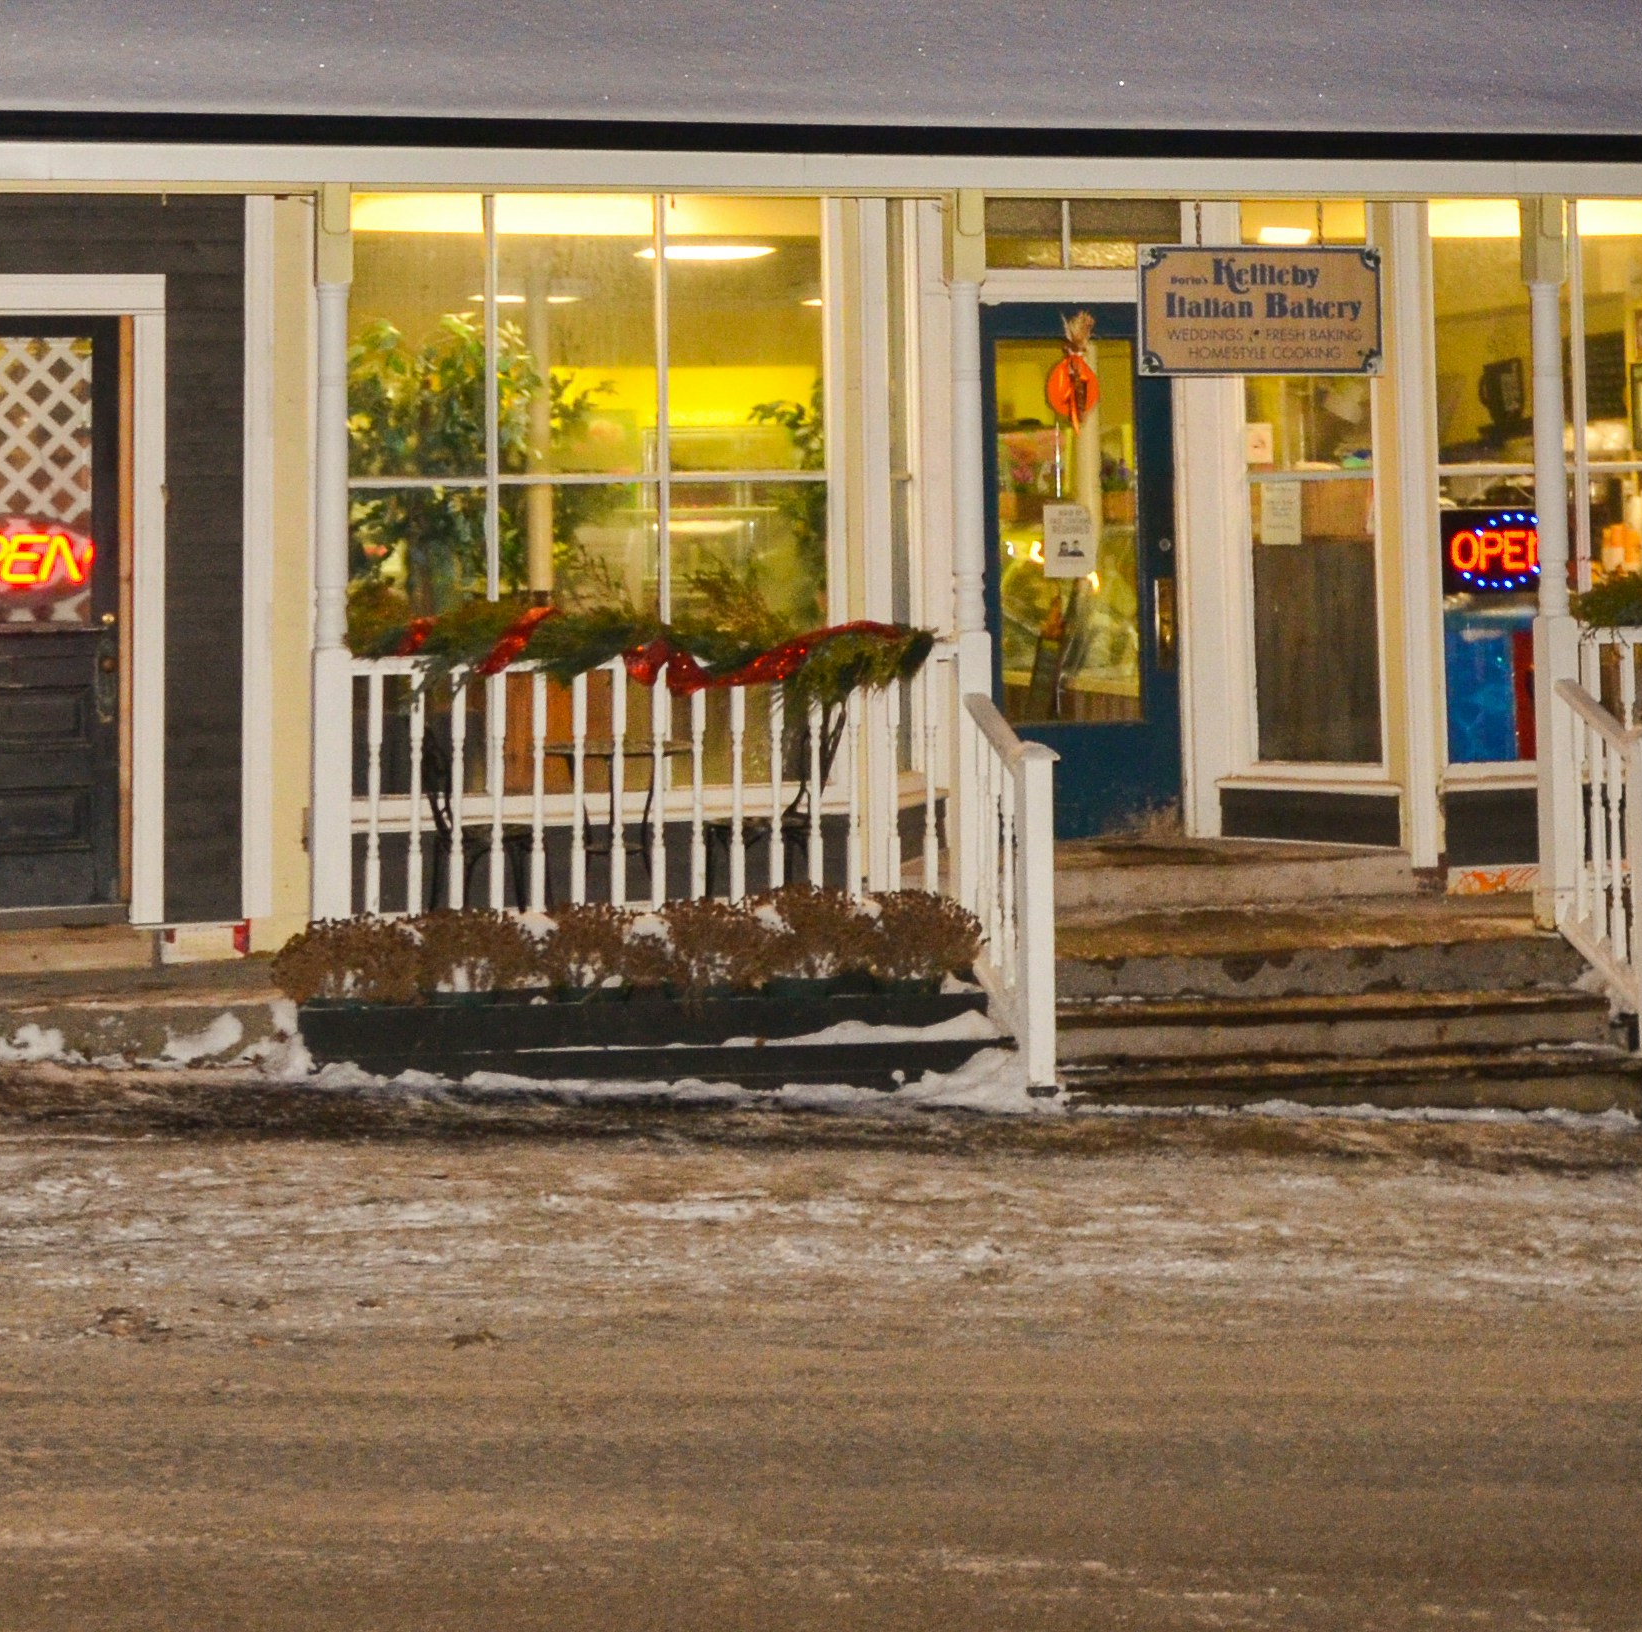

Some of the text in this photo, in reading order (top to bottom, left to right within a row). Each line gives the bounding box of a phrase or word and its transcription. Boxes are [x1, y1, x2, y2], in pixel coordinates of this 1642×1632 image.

[1165, 291, 1363, 322] Italian Bakery
[1168, 328, 1363, 343] WEDDINGS FRESH BAKING
[1188, 346, 1342, 360] HOMESTYLE COOKING
